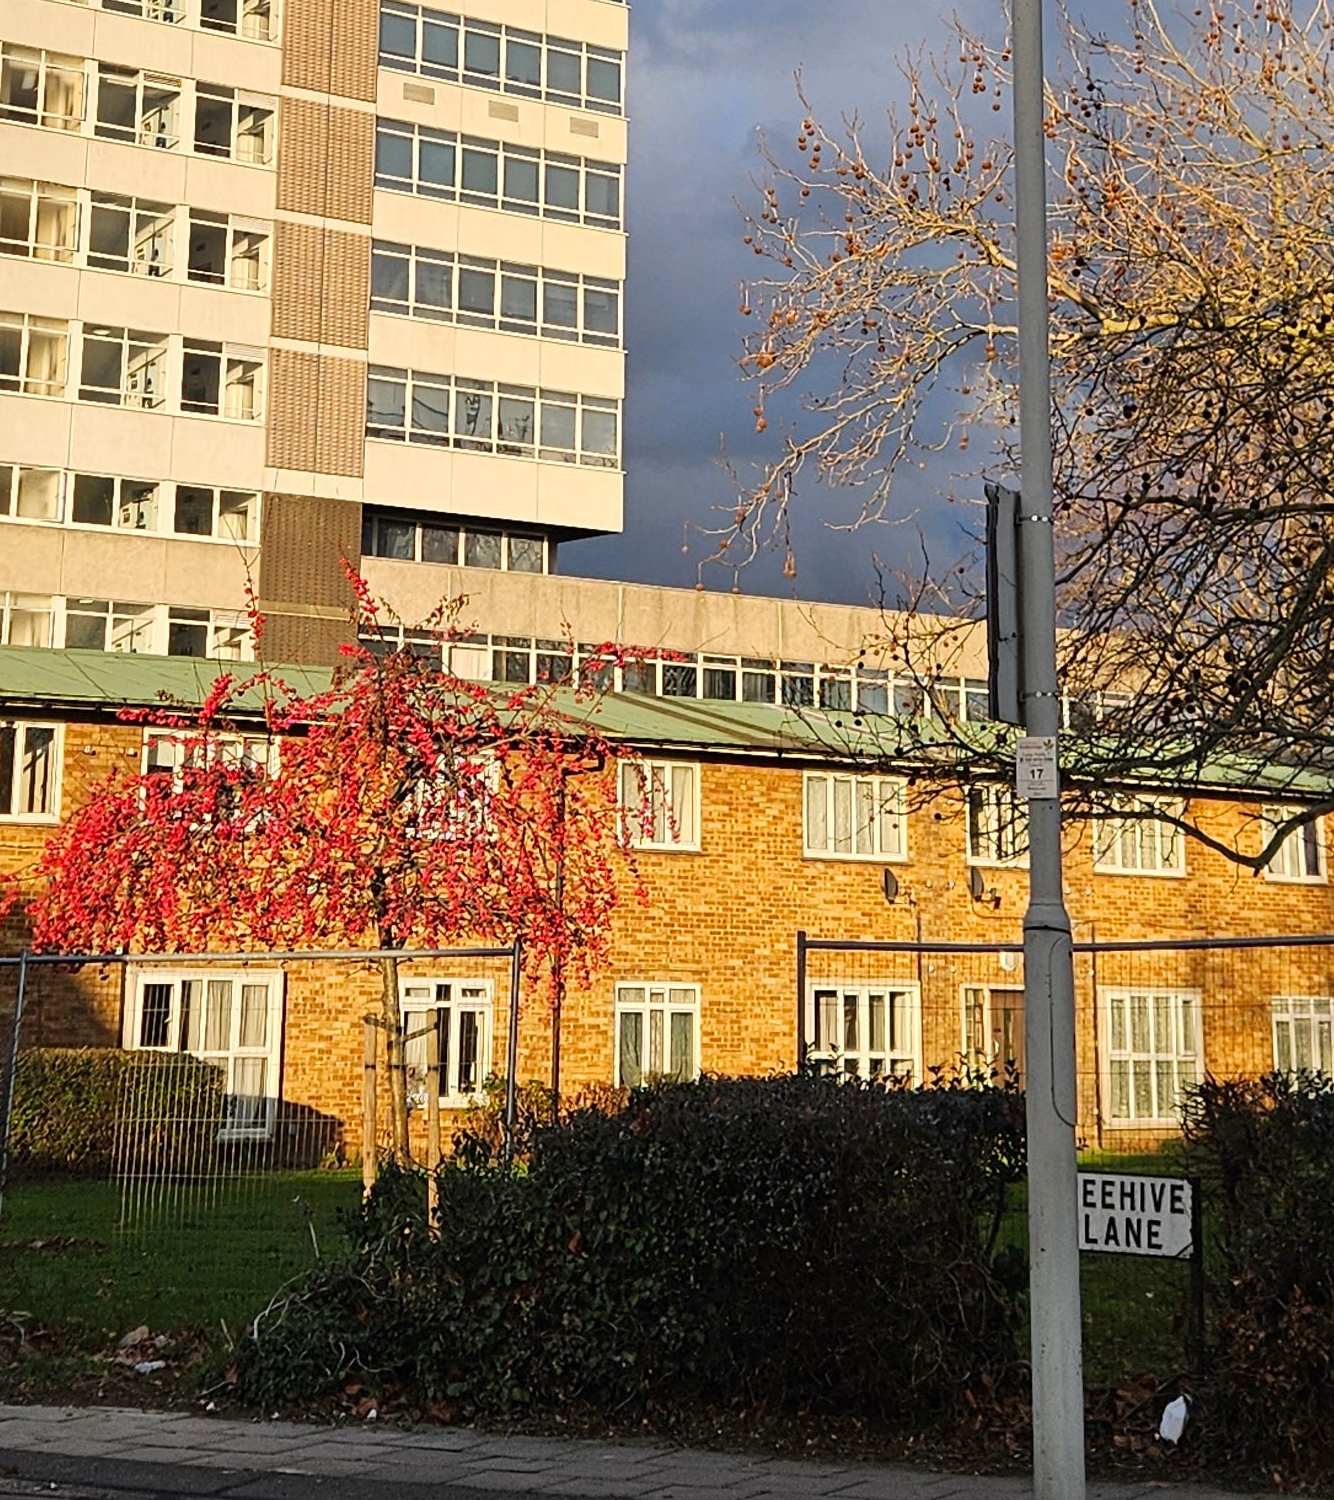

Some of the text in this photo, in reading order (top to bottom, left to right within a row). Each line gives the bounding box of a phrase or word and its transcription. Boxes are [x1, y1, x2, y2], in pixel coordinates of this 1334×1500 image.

[1030, 769, 1044, 779] 17
[1082, 1179, 1185, 1214] EEHIVE
[1084, 1214, 1163, 1249] LANE
